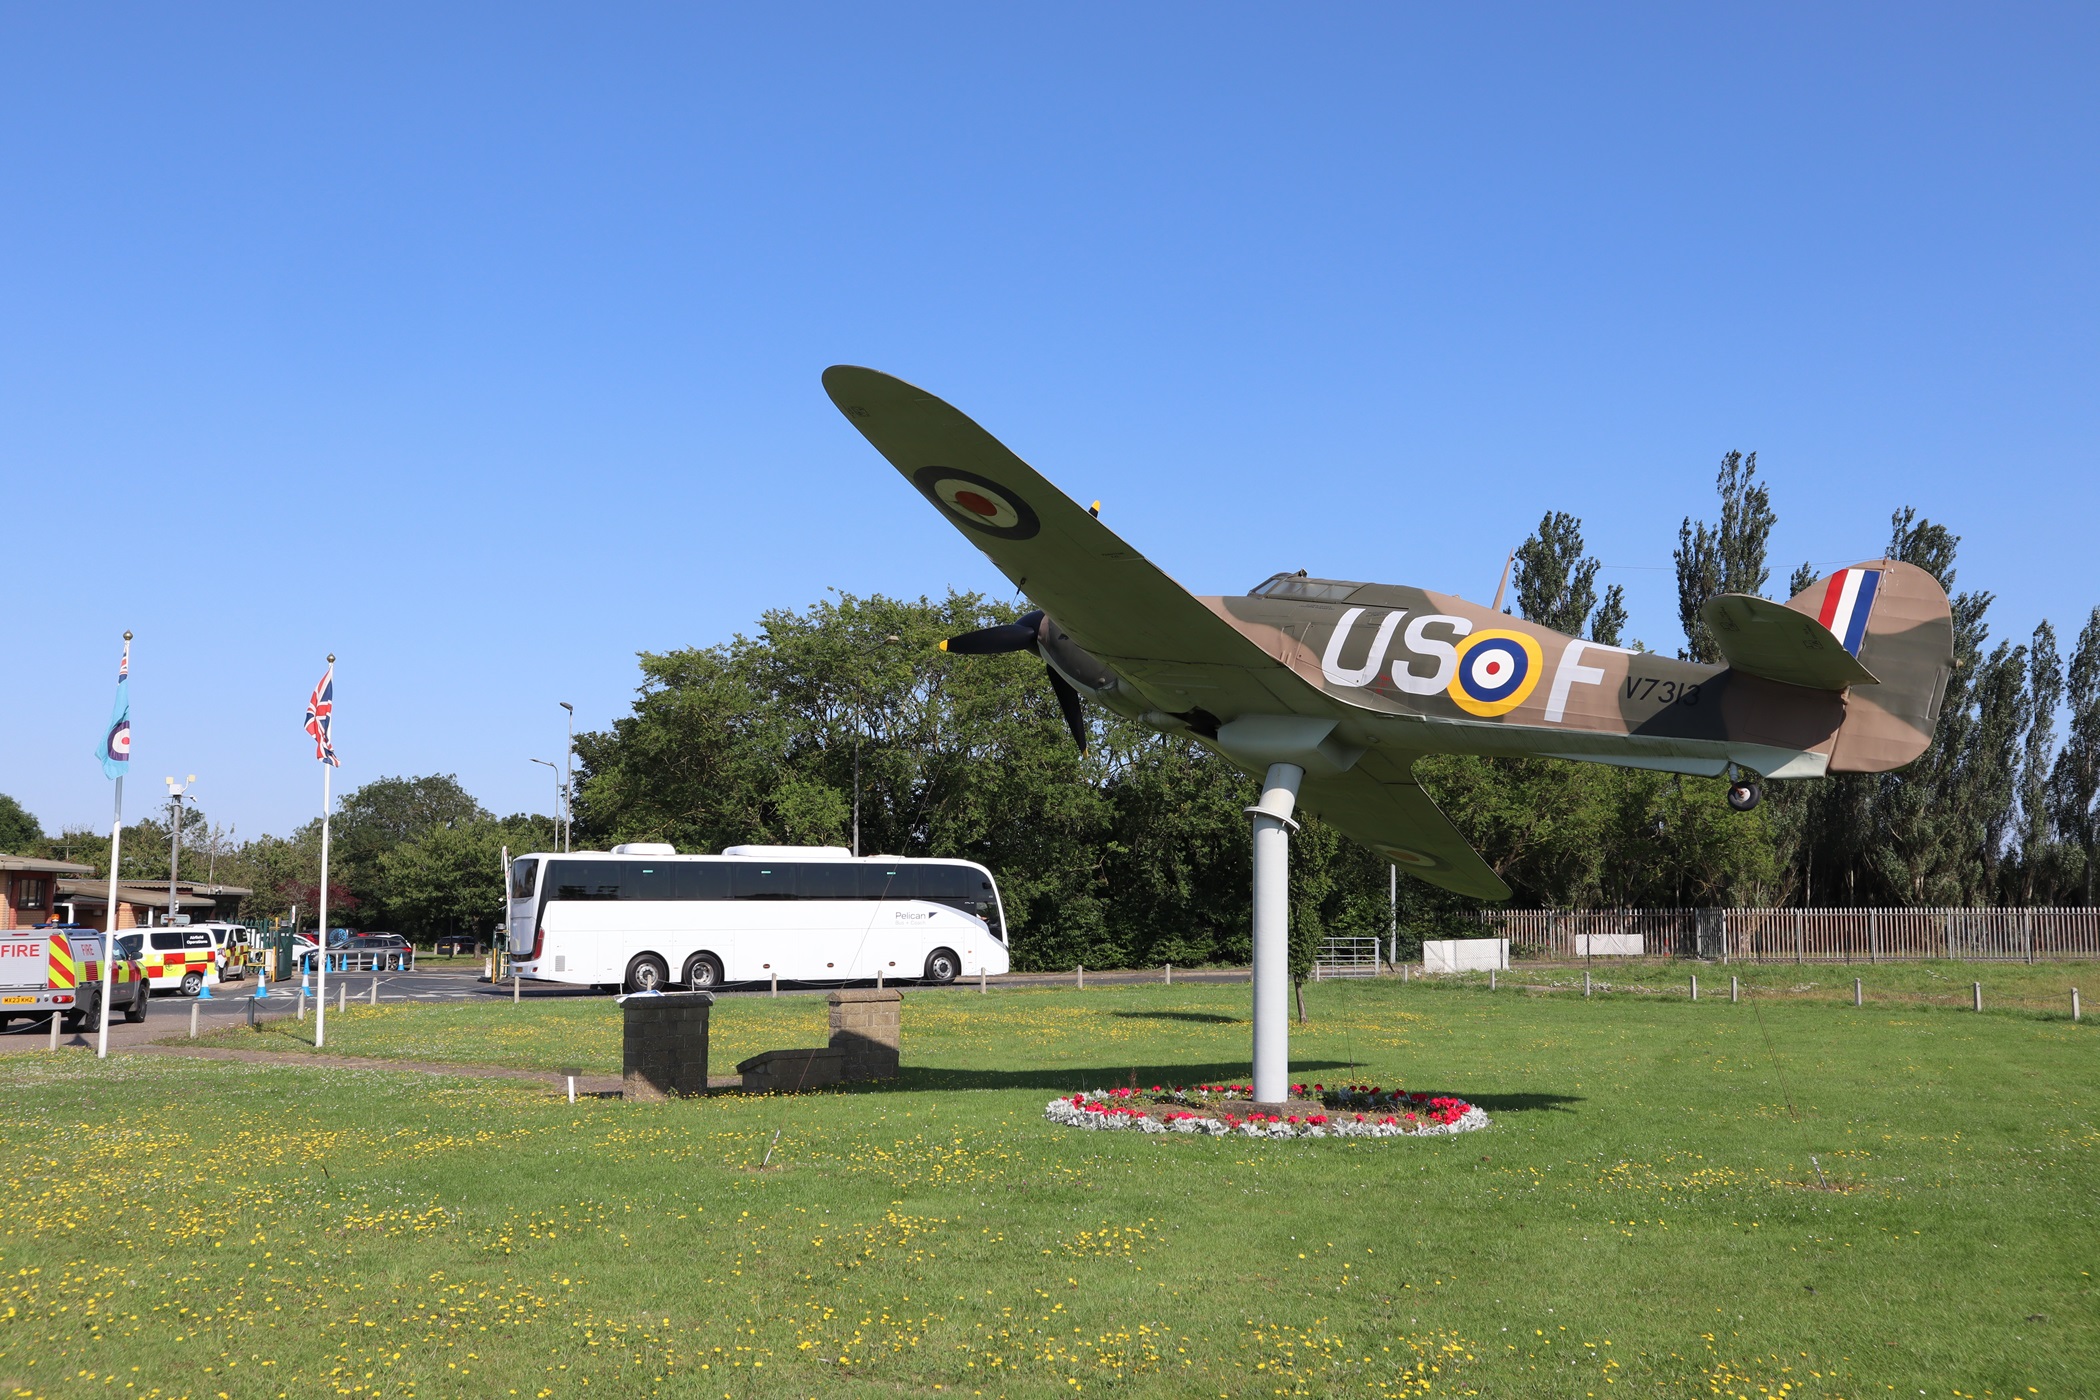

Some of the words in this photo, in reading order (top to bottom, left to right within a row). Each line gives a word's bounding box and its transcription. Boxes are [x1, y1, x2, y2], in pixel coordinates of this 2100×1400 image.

[1321, 608, 1473, 696] US
[1544, 638, 1642, 723] F
[1625, 676, 1701, 707] V7313
[1, 944, 40, 957] FIRE
[81, 944, 94, 956] FIRE
